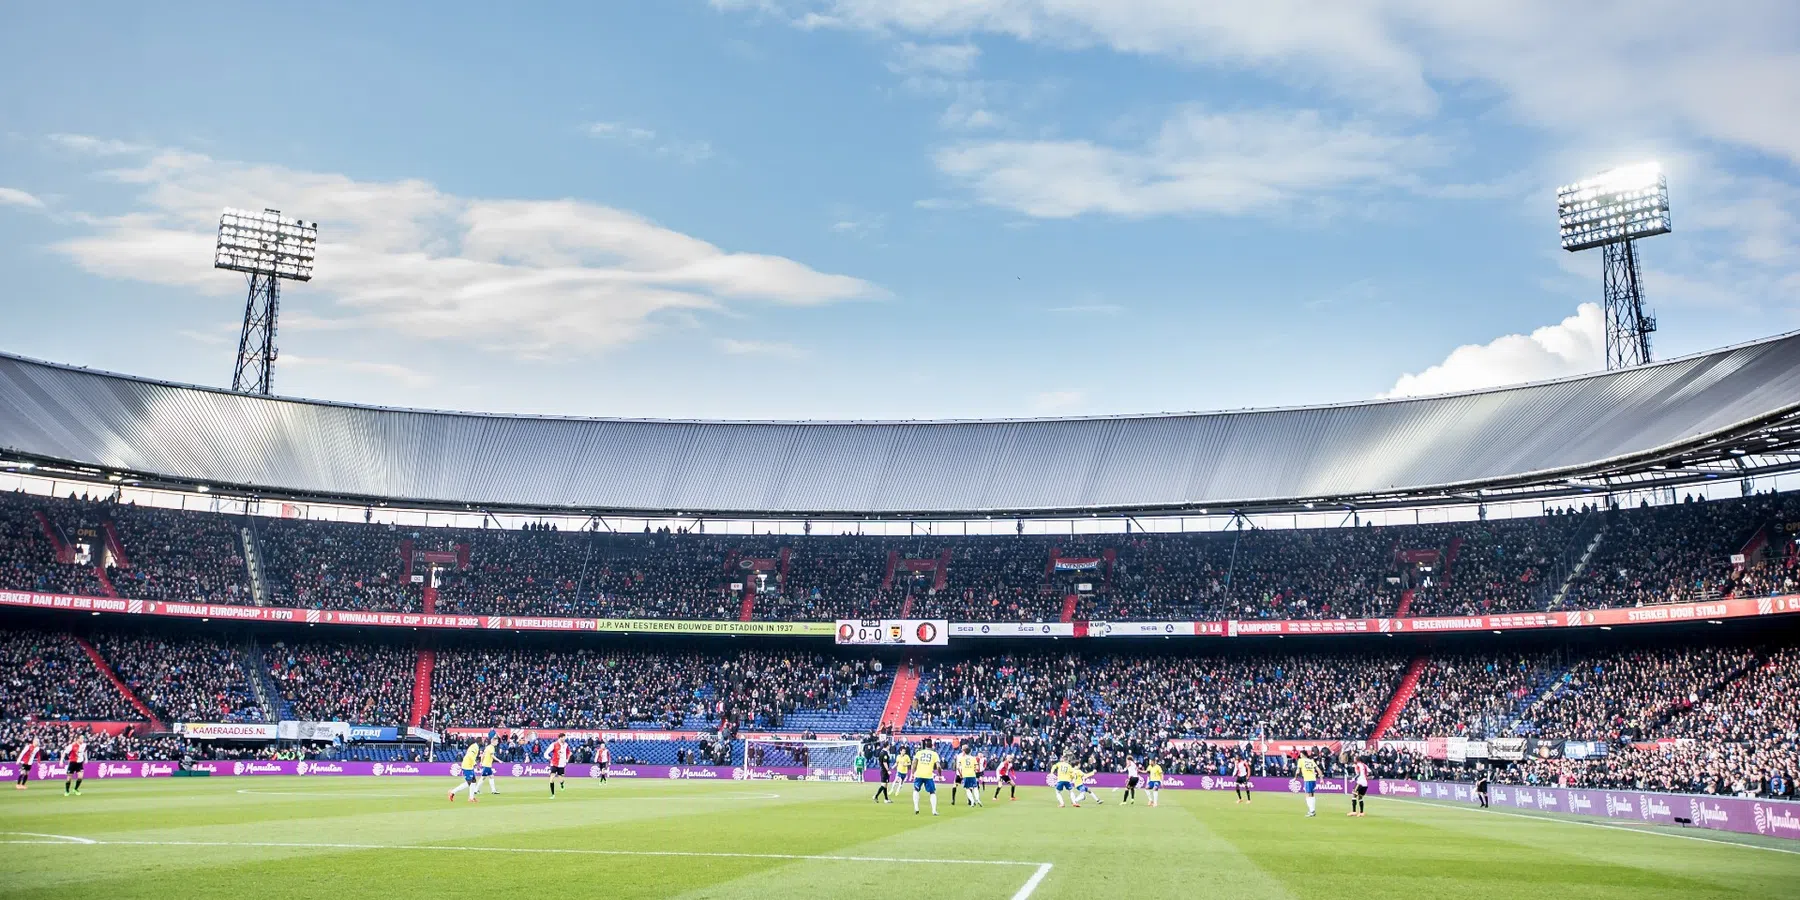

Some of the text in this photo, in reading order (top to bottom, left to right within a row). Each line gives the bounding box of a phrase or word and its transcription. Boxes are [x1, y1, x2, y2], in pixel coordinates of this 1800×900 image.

[77, 528, 98, 538] OPEL
[32, 596, 52, 606] DAN
[54, 598, 72, 607] DAT
[74, 599, 92, 608] ENE
[93, 600, 126, 611] WOORD
[166, 604, 293, 620] WINNAAR EUROPACUP 1 1970
[1627, 604, 1726, 621] STERKER DOOR STRIJD
[338, 612, 479, 627] WINNAAR UEFA CUP 1974 EN 2002
[515, 618, 595, 629] WERELDBEKER 1970
[1412, 618, 1482, 630] BEKERWINNAAR
[614, 621, 631, 630] VAN
[633, 621, 675, 631] EESTEREN
[678, 622, 712, 631] BOUWDE
[714, 622, 728, 631] DIT
[729, 623, 764, 632] STADION
[766, 623, 774, 632] IN
[776, 624, 793, 632] 1937
[192, 726, 266, 735] KAMERAADJES.NL
[107, 763, 132, 776] Manutan
[245, 762, 281, 774] Manutan
[309, 762, 343, 774] Manutan
[384, 763, 419, 774] Manutan
[681, 767, 717, 778] Manutan
[1388, 783, 1416, 794] Manutan
[1648, 797, 1671, 819] Manutan
[1700, 801, 1728, 825] Manutan
[1766, 806, 1800, 832] Manutan
